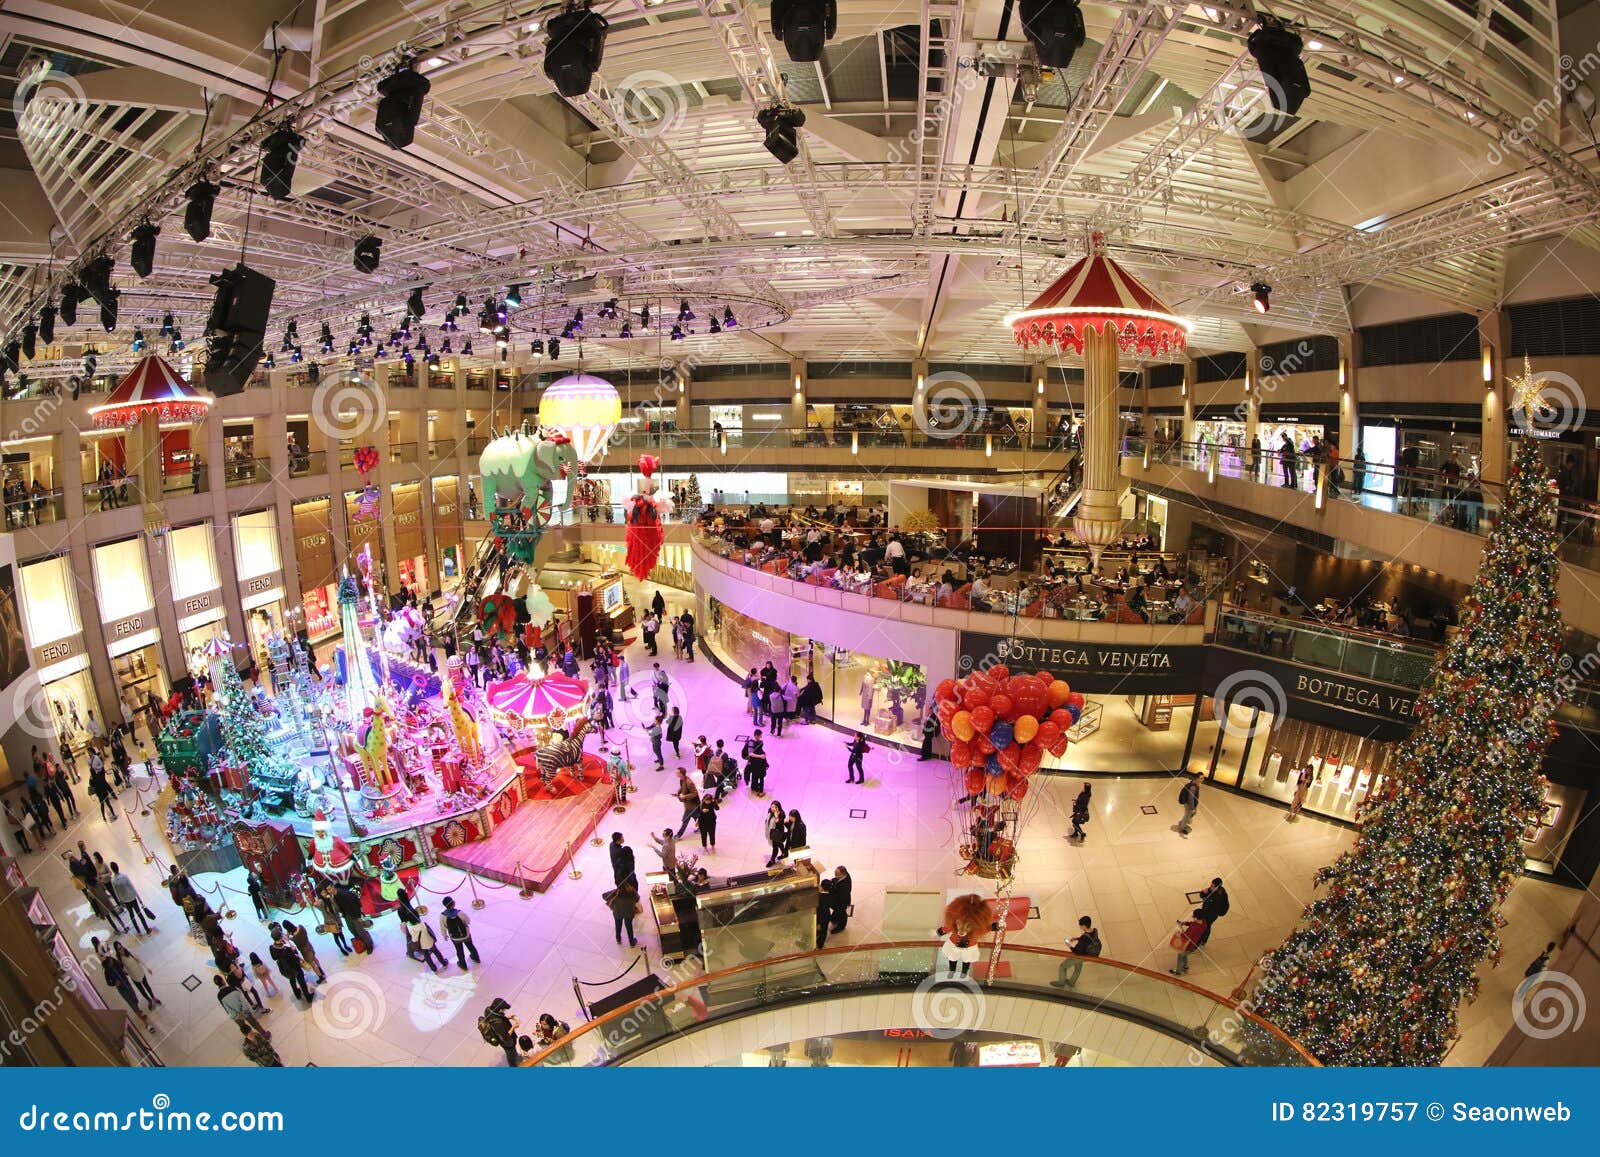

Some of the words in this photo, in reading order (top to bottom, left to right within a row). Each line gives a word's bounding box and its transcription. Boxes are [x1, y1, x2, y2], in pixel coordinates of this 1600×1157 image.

[250, 576, 273, 591] FENDI
[186, 596, 211, 613] FENDI
[116, 617, 144, 636] FENDI
[42, 642, 72, 662] FENDI
[998, 644, 1090, 665] BOTTEGA
[1098, 651, 1172, 668] VENETA
[1297, 675, 1381, 709] BOTTEGA
[883, 1029, 935, 1039] ISAIA
